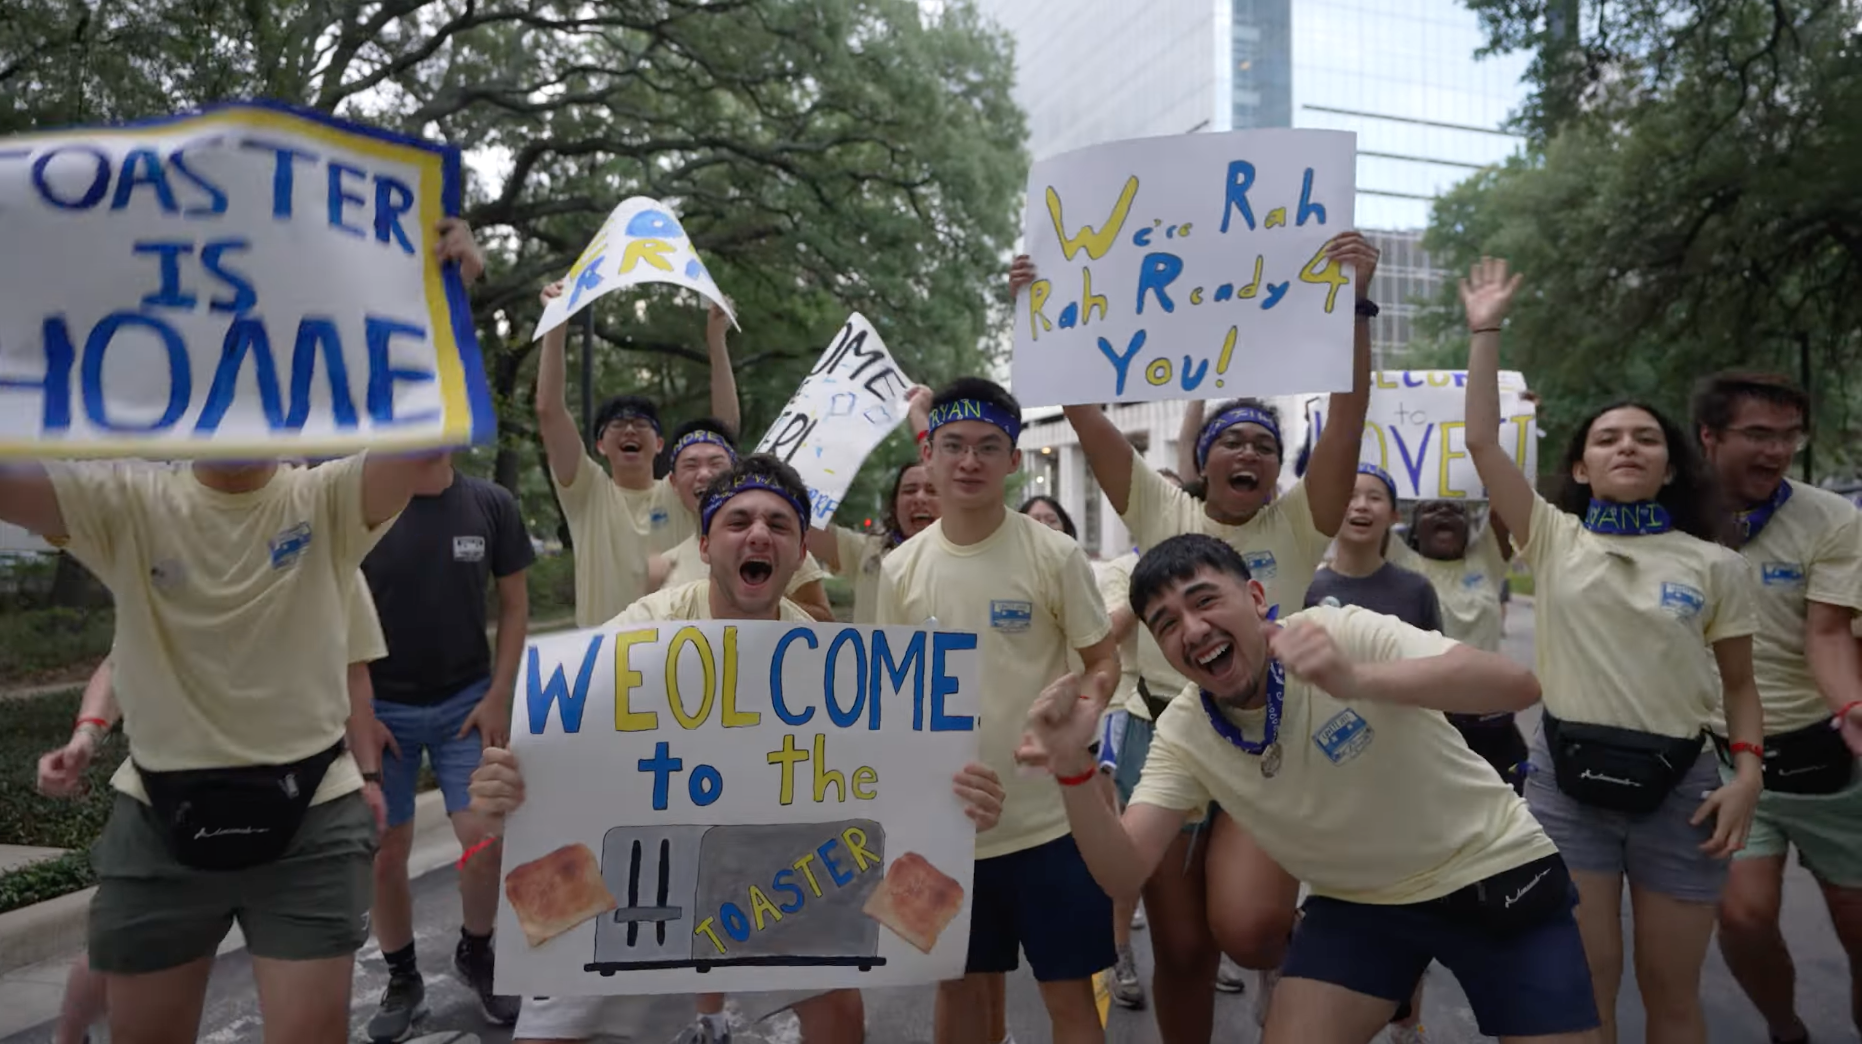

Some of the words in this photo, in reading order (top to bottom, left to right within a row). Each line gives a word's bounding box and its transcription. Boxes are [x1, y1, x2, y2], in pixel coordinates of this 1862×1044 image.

[1219, 160, 1327, 235] Rah
[133, 235, 259, 314] IS
[1029, 266, 1108, 342] Rah
[1135, 252, 1290, 315] Ready
[1299, 239, 1349, 314] 4
[1097, 324, 1238, 397] You!
[930, 400, 981, 428] RYAN
[1394, 401, 1429, 426] to
[525, 625, 978, 735] WEOLCOME
[637, 741, 724, 811] to
[766, 733, 879, 806] the
[694, 826, 881, 955] TOASTER
